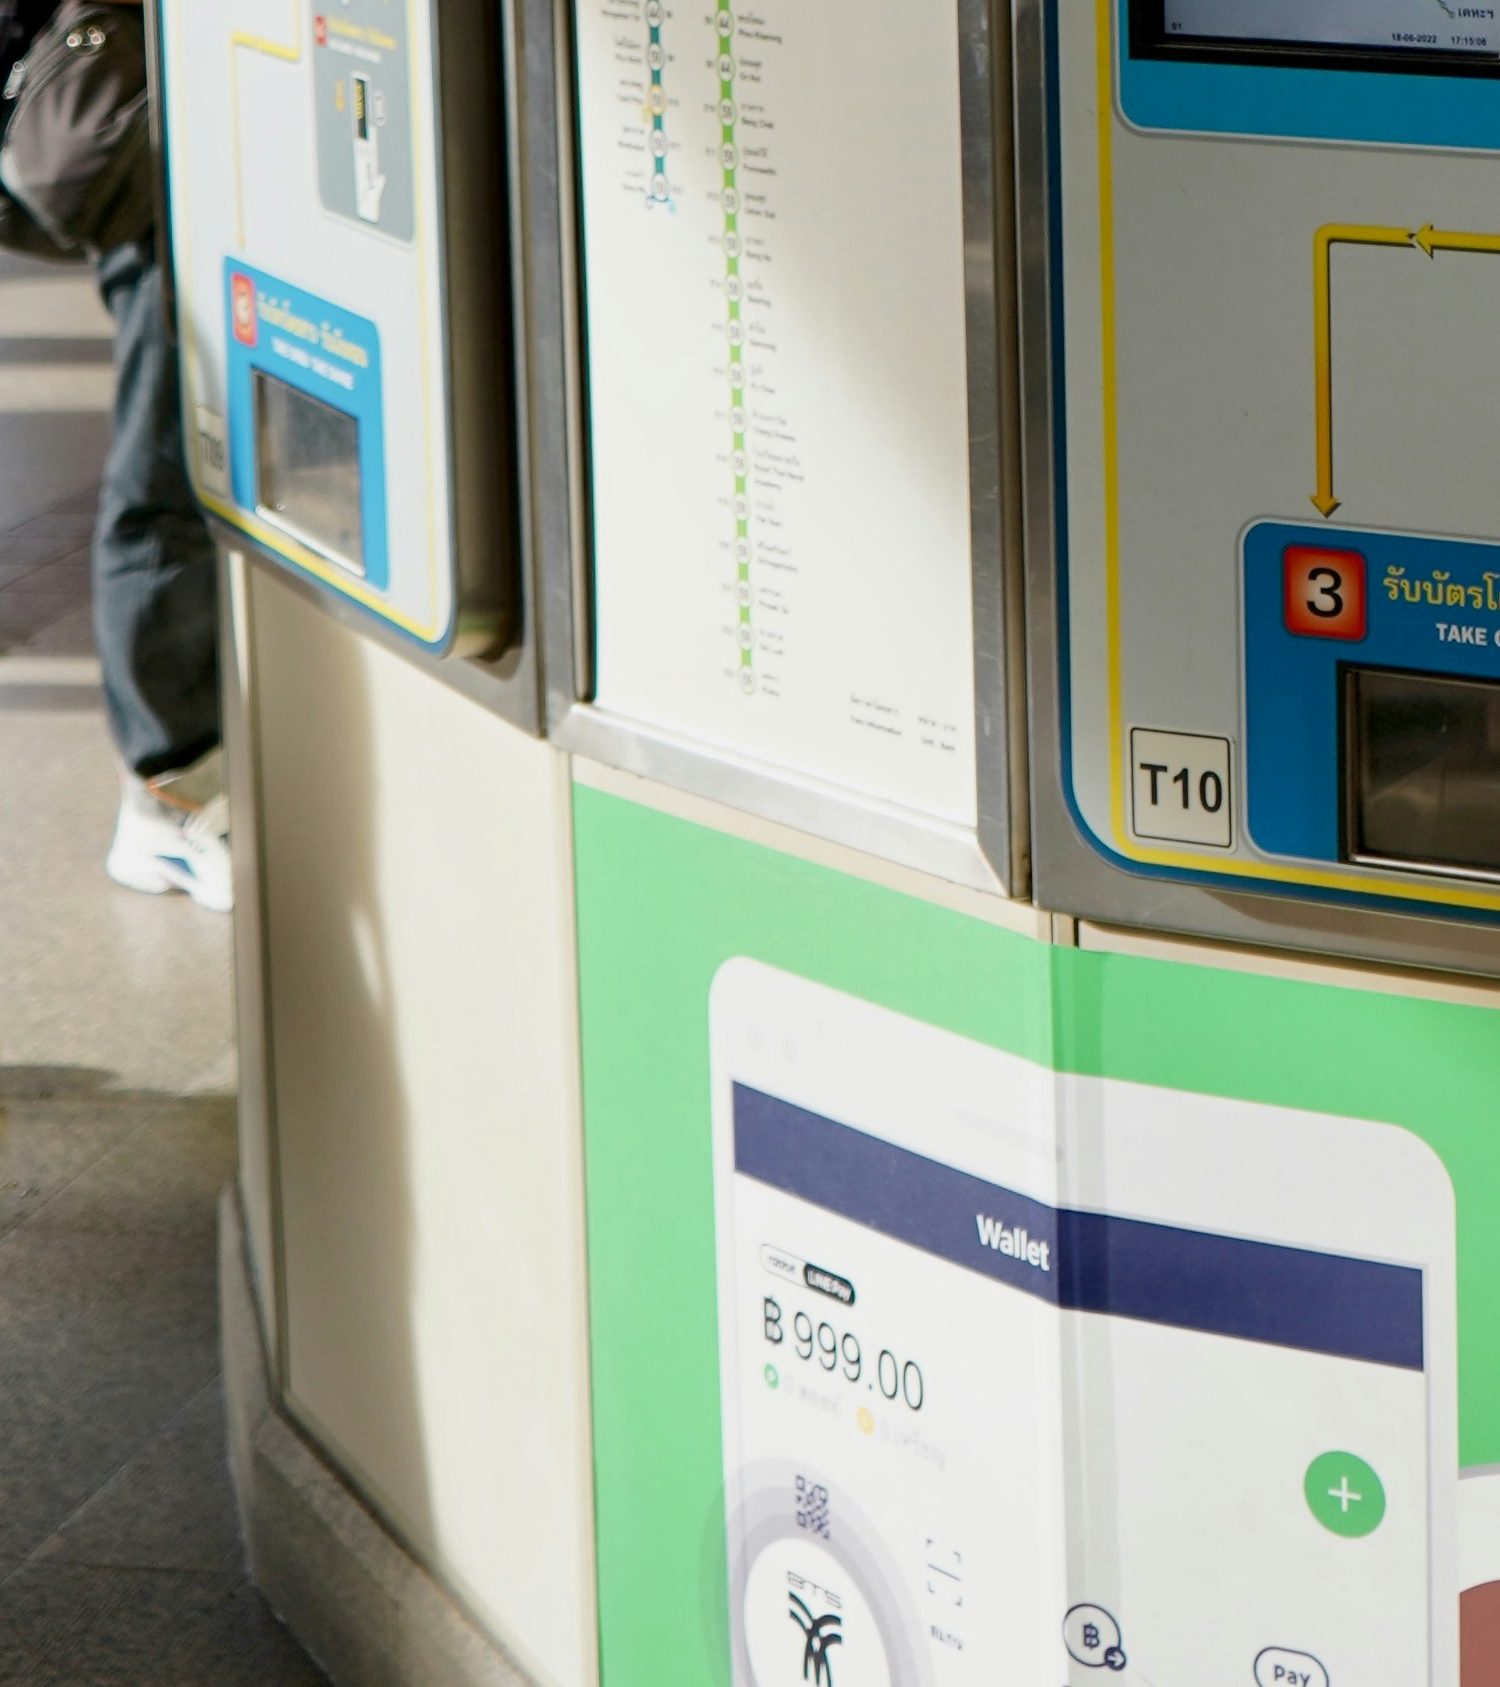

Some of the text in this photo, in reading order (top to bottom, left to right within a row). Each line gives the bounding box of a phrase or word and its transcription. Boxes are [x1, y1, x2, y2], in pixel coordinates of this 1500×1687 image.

[1305, 567, 1345, 620] 3
[1436, 623, 1488, 648] TAKE
[1141, 762, 1222, 814] T10
[975, 1213, 1051, 1273] Wallet
[1273, 1659, 1311, 1687] Pay
